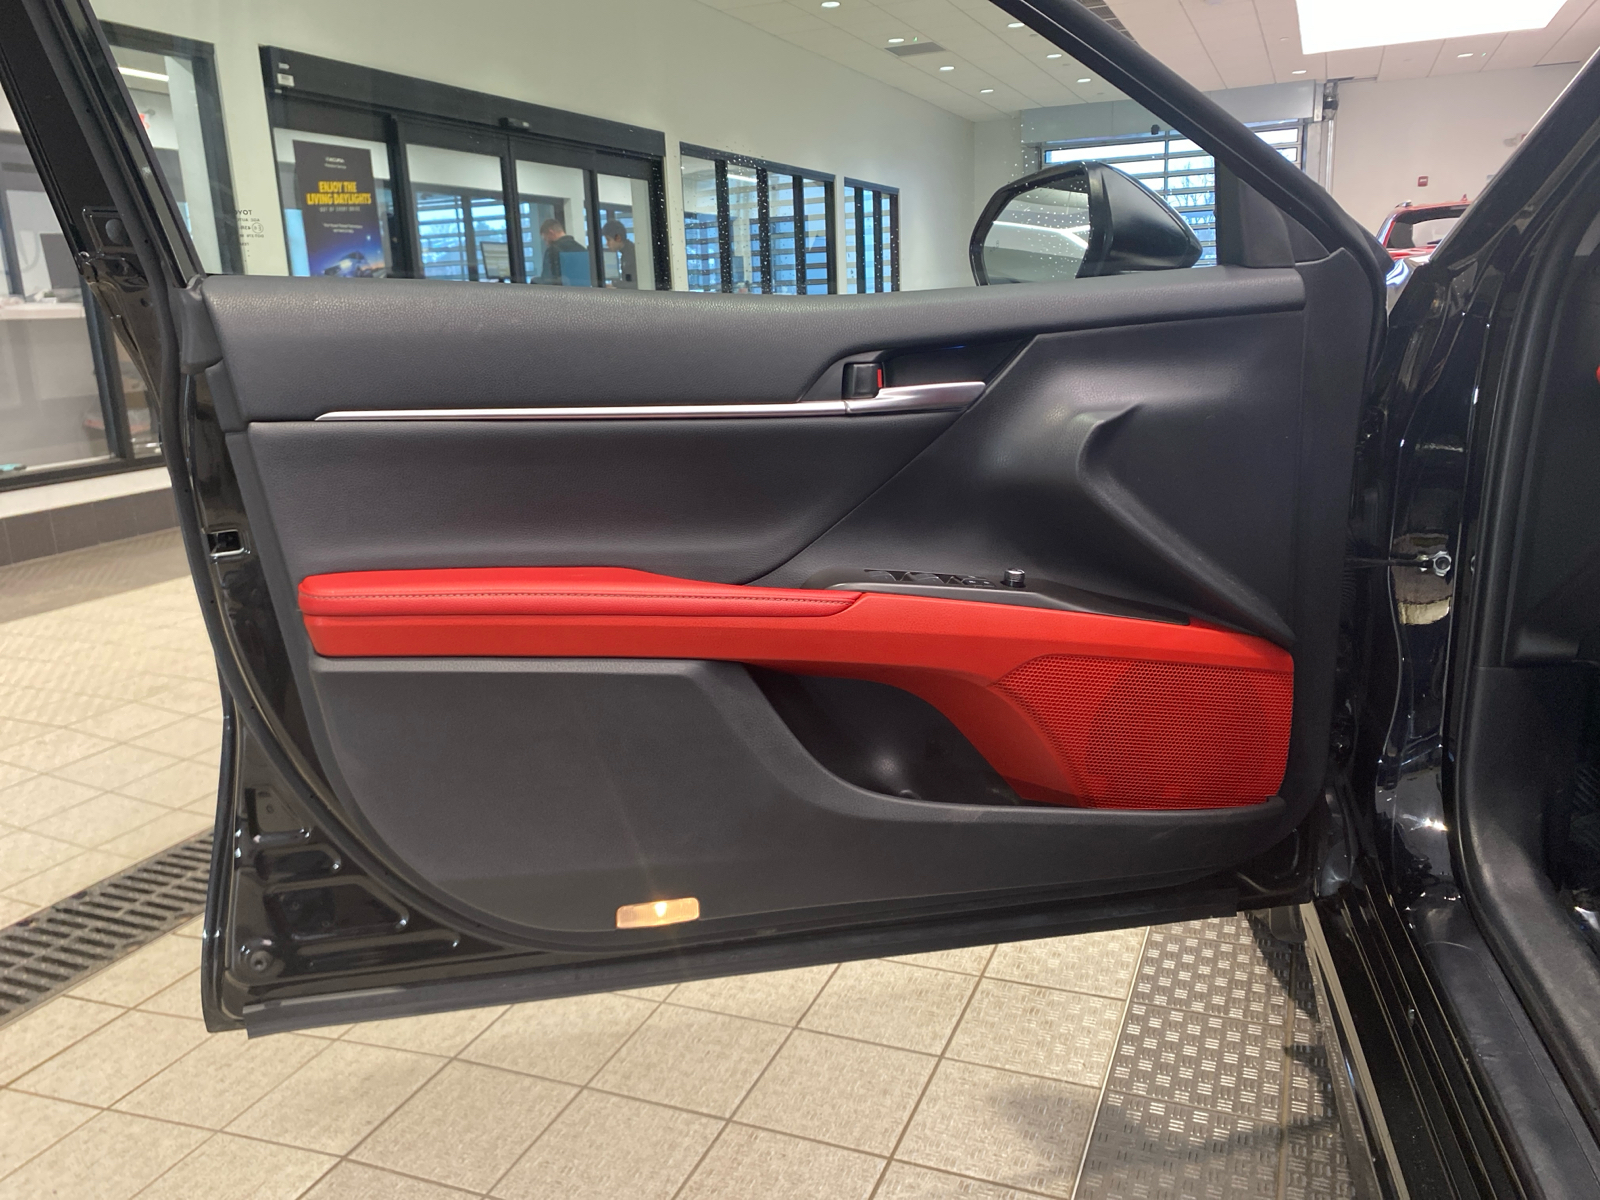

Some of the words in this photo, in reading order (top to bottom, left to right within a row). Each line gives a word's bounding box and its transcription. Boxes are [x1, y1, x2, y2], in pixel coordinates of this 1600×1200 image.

[318, 181, 342, 193] ENJOY
[343, 181, 357, 193] THE
[306, 192, 333, 205] LIVING
[333, 192, 371, 205] DAYLIGHTS
